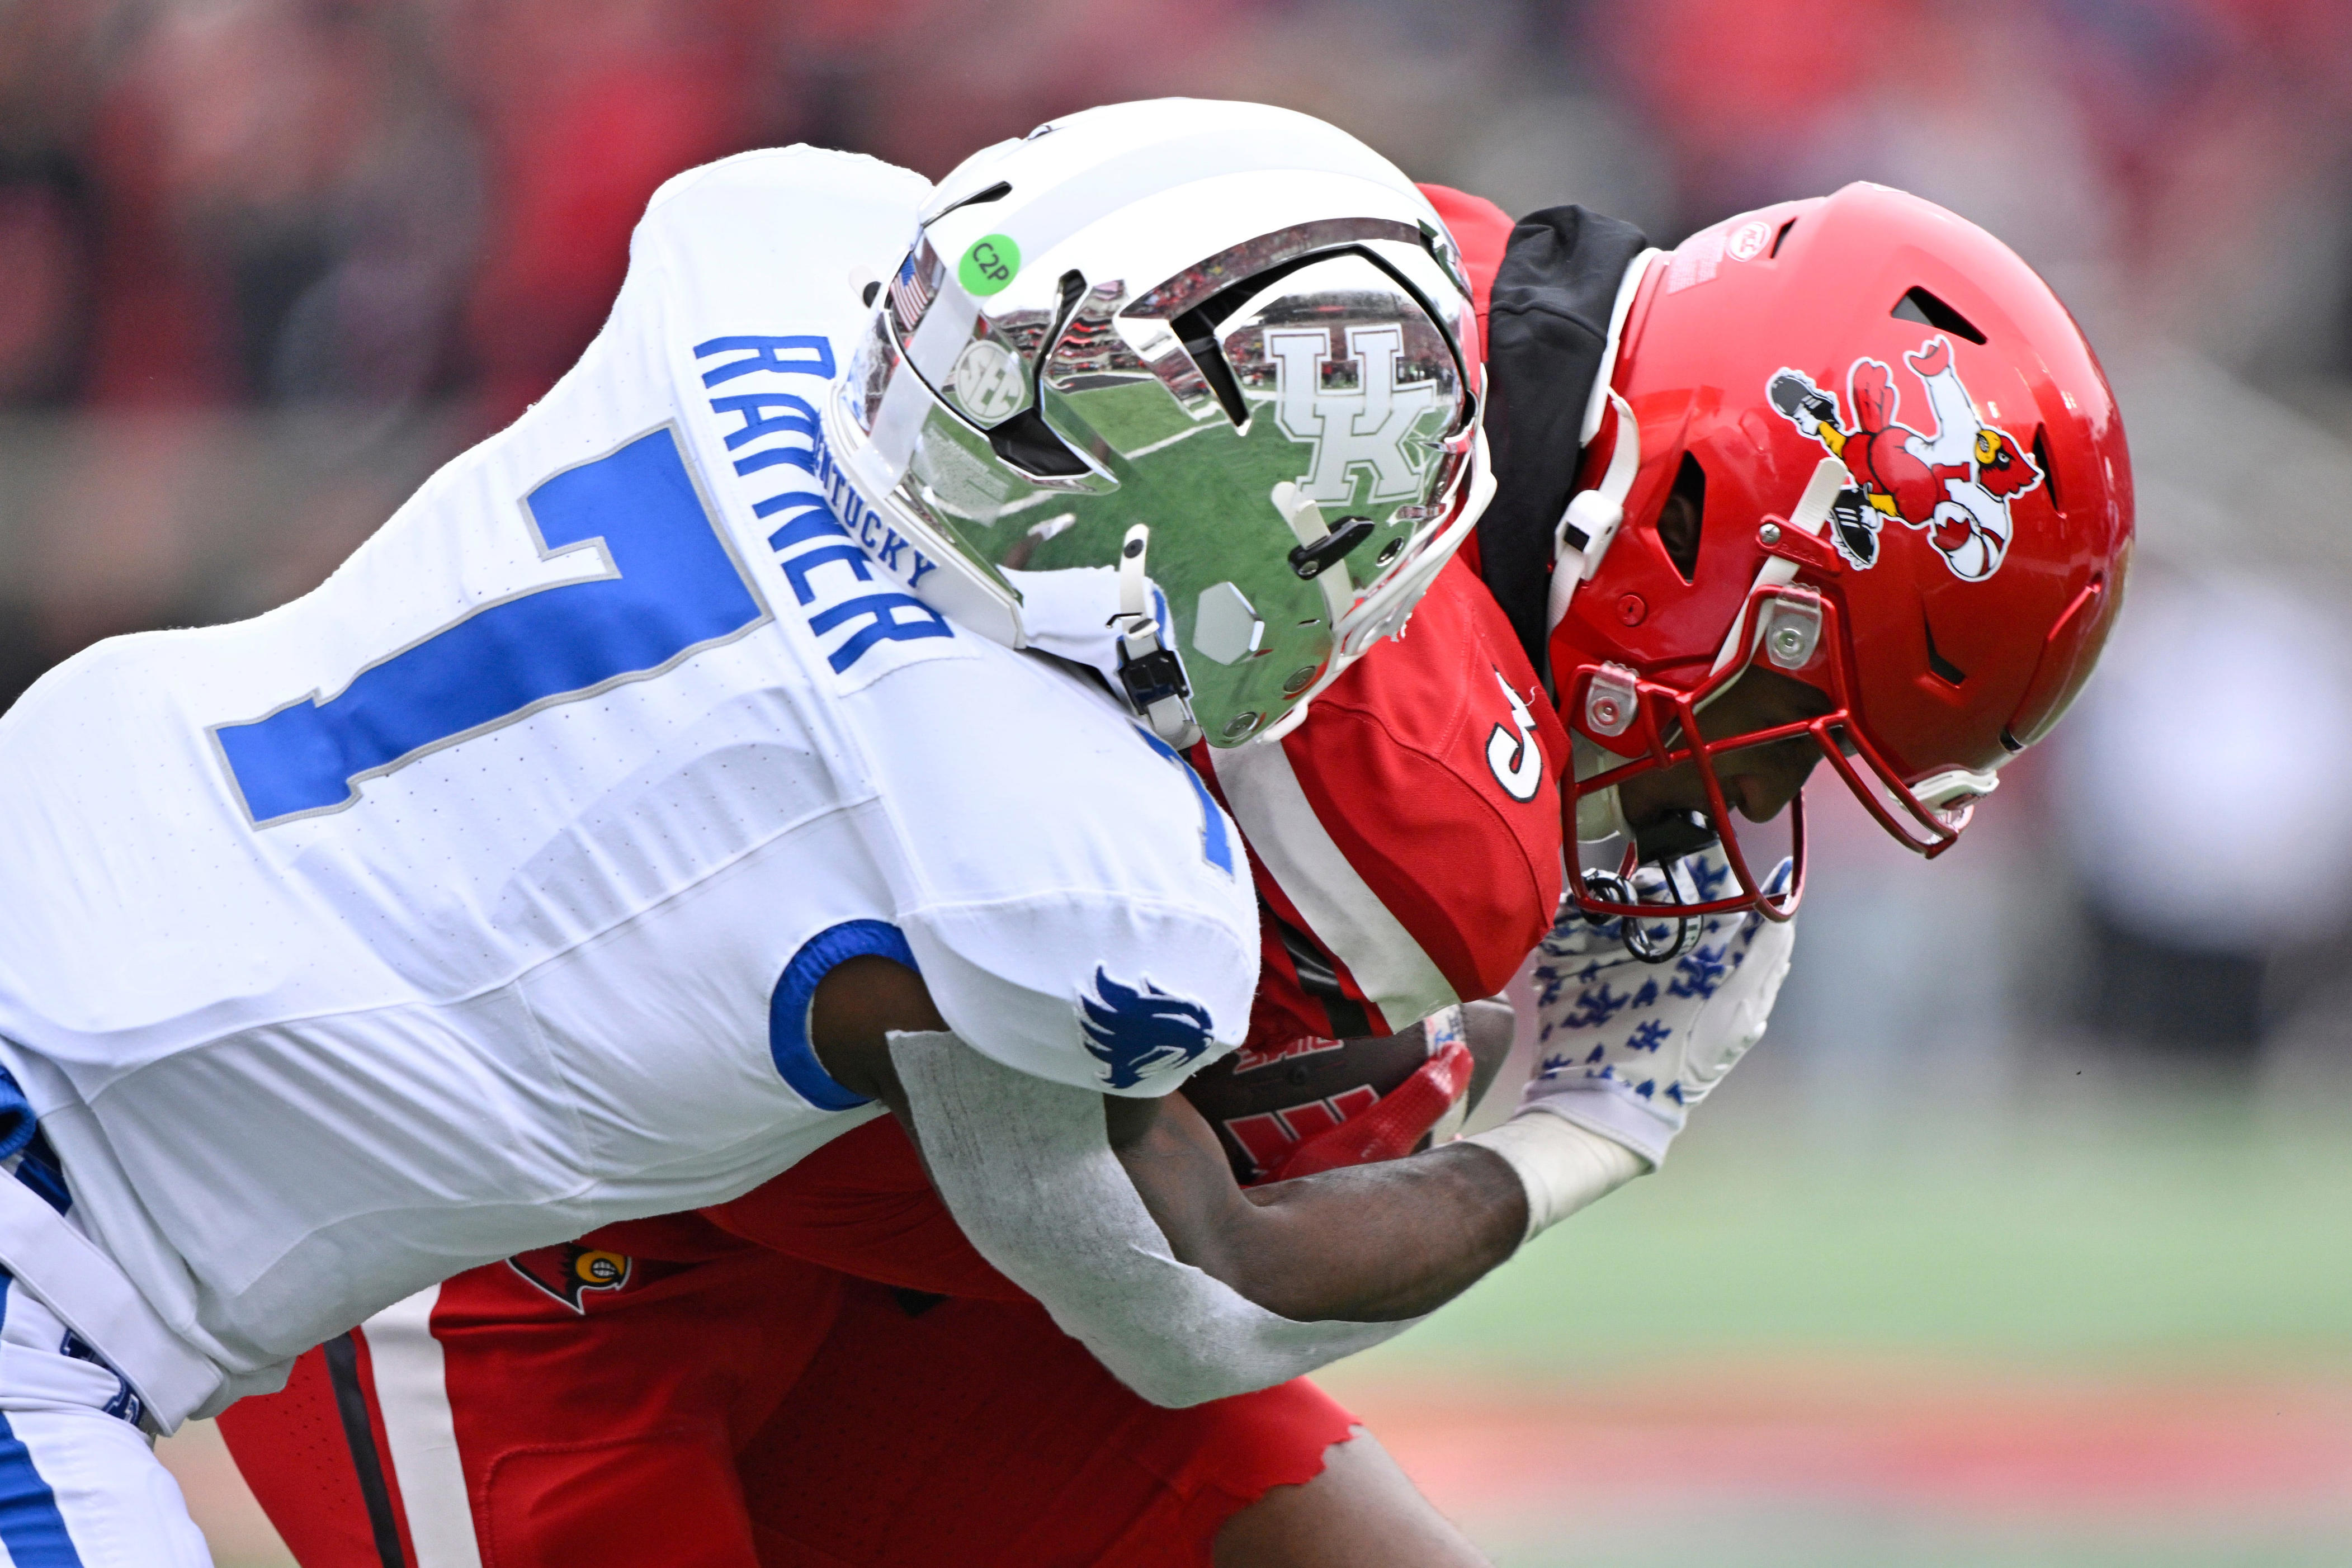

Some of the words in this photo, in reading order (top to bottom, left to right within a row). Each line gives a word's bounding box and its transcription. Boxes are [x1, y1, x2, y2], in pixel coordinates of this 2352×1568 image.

[972, 243, 1009, 281] C2P
[958, 345, 1022, 418] SEC
[1263, 324, 1437, 507] UK
[205, 417, 775, 832] 7
